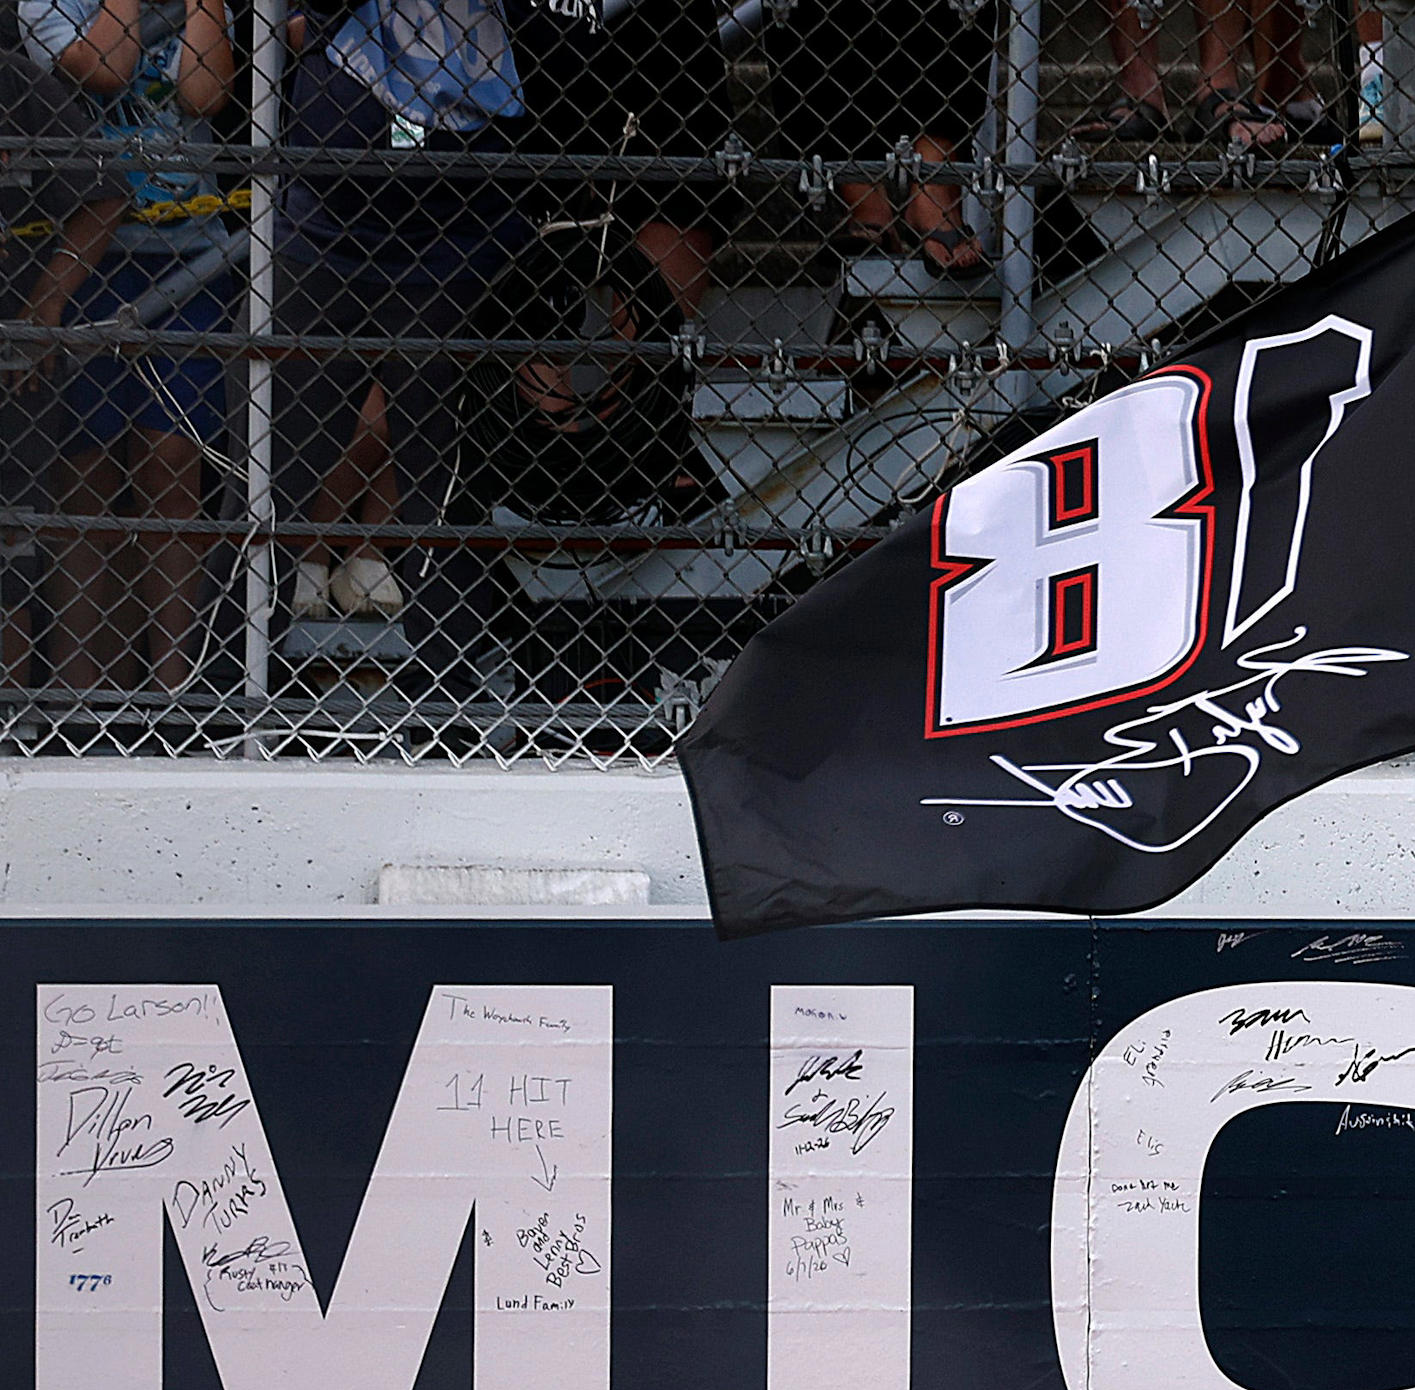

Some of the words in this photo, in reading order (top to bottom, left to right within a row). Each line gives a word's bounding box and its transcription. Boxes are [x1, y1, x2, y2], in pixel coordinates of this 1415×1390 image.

[510, 1074, 573, 1106] HIT
[491, 1115, 565, 1143] HERE
[68, 1273, 112, 1293] 1776
[496, 1296, 527, 1312] Lund
[533, 1295, 576, 1313] Family
